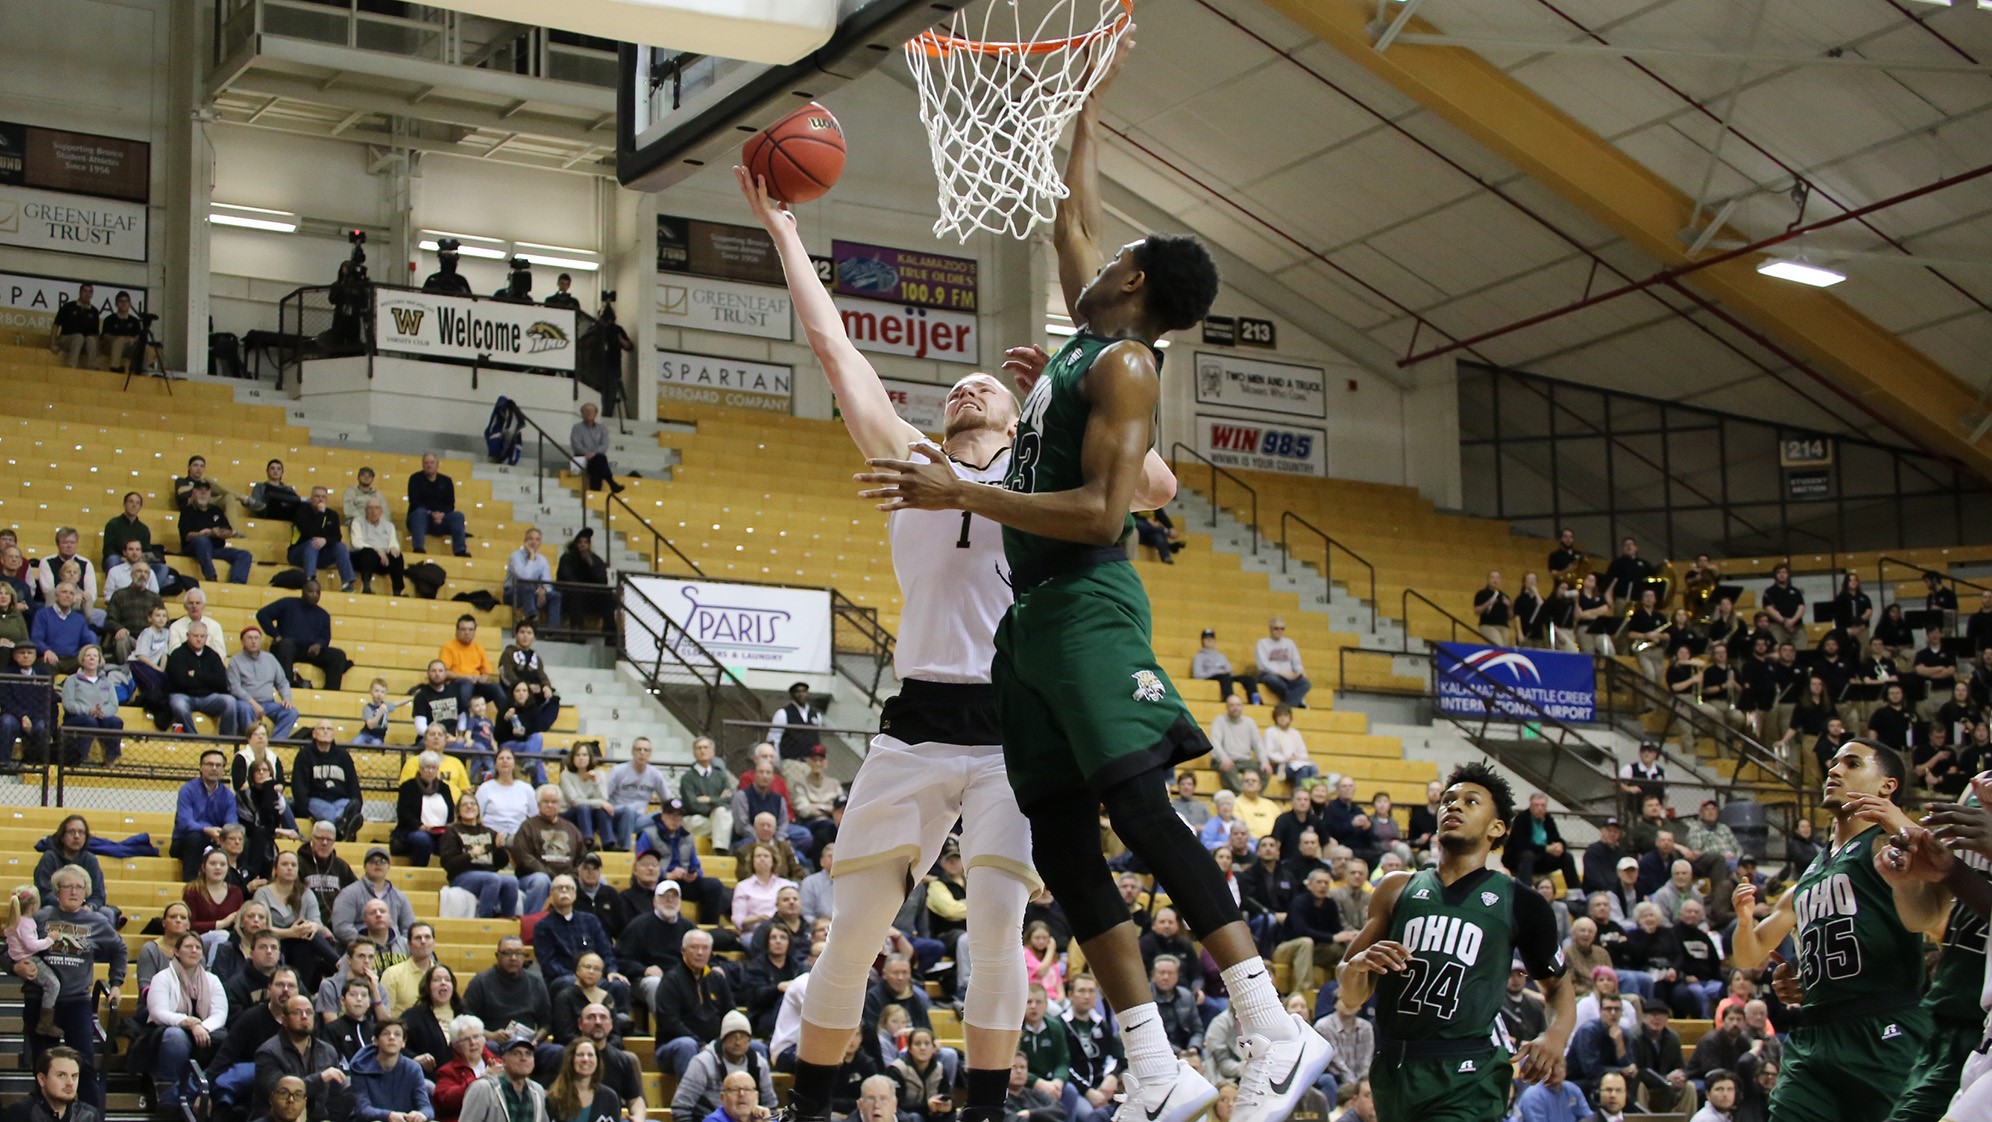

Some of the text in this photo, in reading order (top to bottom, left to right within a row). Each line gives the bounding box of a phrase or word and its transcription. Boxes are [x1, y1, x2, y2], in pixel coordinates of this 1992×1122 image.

[97, 147, 124, 158] Bronco
[65, 162, 110, 175] Since 1956
[24, 203, 137, 231] GREENLEAF
[45, 223, 116, 245] TRUST
[812, 260, 832, 280] 12
[897, 254, 976, 274] KALAMAZOO'S
[899, 266, 928, 281] TRUE
[693, 288, 788, 314] GREENLEAF
[901, 282, 974, 307] 100.9 FM
[391, 307, 424, 336] W
[711, 305, 769, 326] TRUST
[438, 306, 521, 353] Welcome
[841, 306, 970, 358] meijer
[1242, 321, 1270, 341] 213
[663, 362, 789, 392] SPARTAN
[1226, 370, 1245, 382] TWO
[1247, 373, 1265, 384] MEN
[1268, 376, 1285, 387] AND
[1287, 378, 1293, 388] A
[725, 393, 789, 410] COMPANY
[1211, 424, 1260, 453] WIN
[1787, 440, 1824, 458] 214
[1242, 456, 1249, 466] IS
[1252, 457, 1275, 469] YOUR
[1276, 460, 1315, 474] COUNTRY
[541, 507, 551, 515] 14
[562, 528, 573, 536] 13
[956, 510, 972, 548] 1
[742, 653, 783, 661] LAUNDRY
[585, 683, 592, 694] 6
[1557, 690, 1593, 705] CREEK
[612, 708, 619, 720] 5
[1543, 704, 1592, 720] AIRPORT
[1403, 915, 1484, 967] OHIO
[1800, 917, 1861, 991] 35
[1397, 957, 1466, 1020] 24
